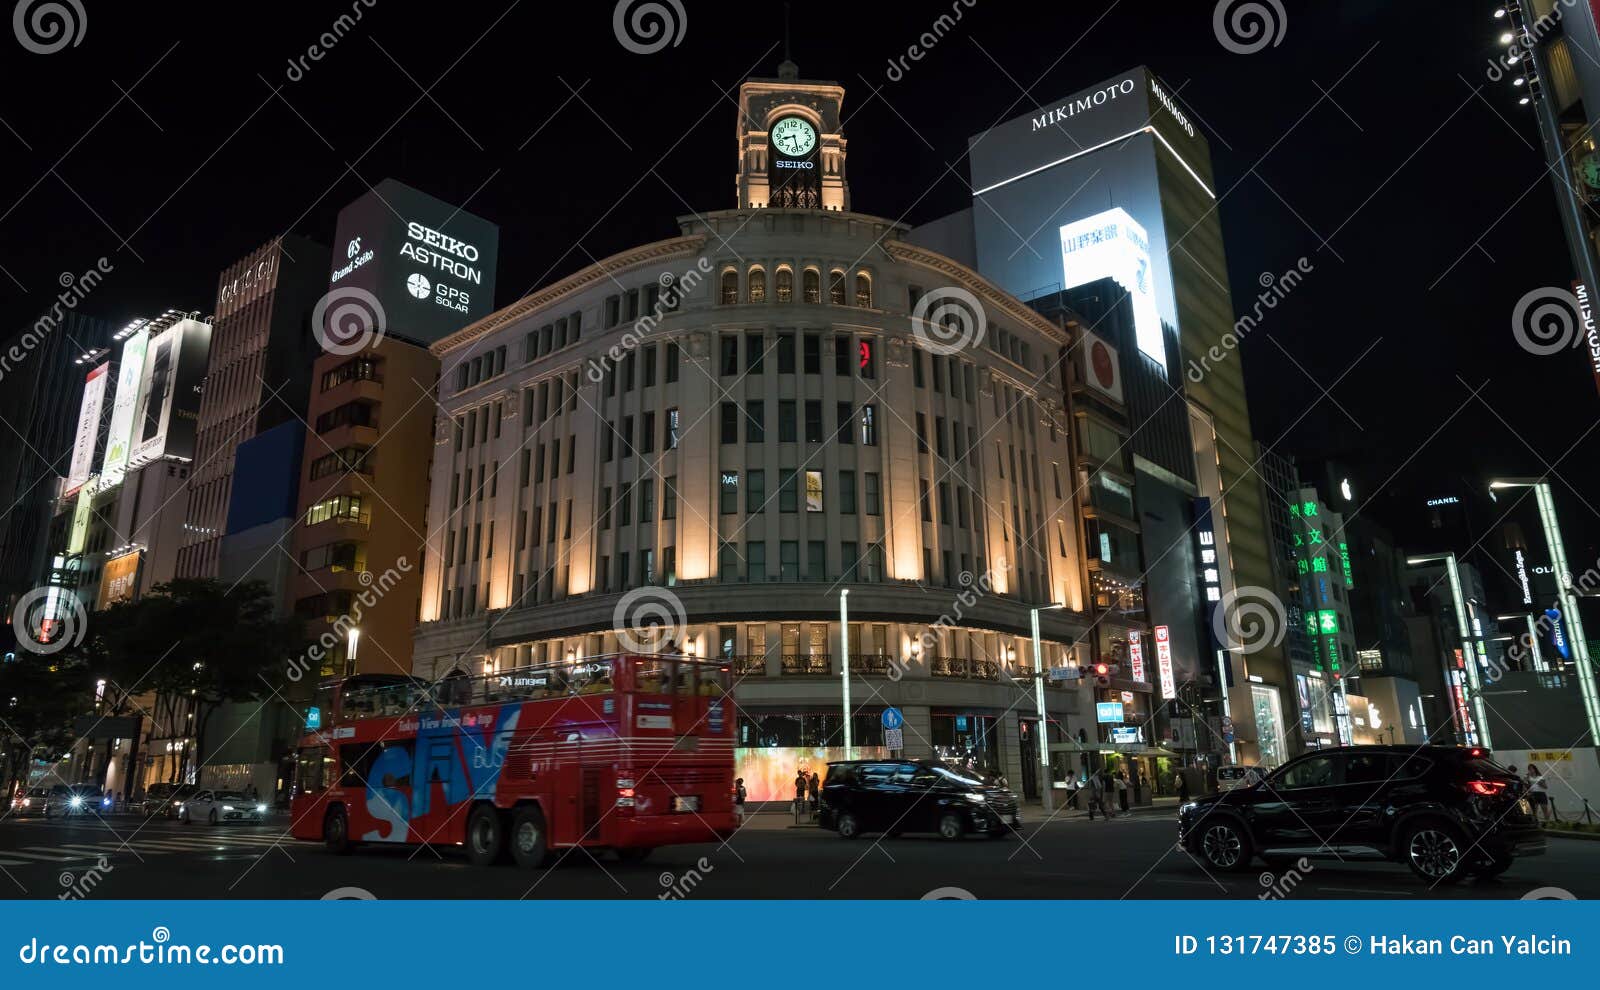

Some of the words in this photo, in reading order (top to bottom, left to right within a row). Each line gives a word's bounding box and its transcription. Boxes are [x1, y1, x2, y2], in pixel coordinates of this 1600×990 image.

[1031, 79, 1135, 131] MIKIMOTO
[1151, 79, 1194, 137] MIKIMOTO
[790, 120, 798, 128] 12
[804, 127, 810, 135] 2
[778, 139, 784, 147] 8
[791, 146, 797, 154] 6
[798, 144, 804, 152] 5
[776, 160, 814, 169] SEIKO
[407, 221, 479, 262] SEIKO
[353, 249, 374, 269] Seiko
[399, 242, 481, 285] ASTRON
[436, 283, 470, 305] GPS
[435, 296, 469, 314] SOLAR
[1427, 496, 1459, 506] CHANEL
[1303, 501, 1327, 573] 教文館
[1319, 612, 1336, 630] 本
